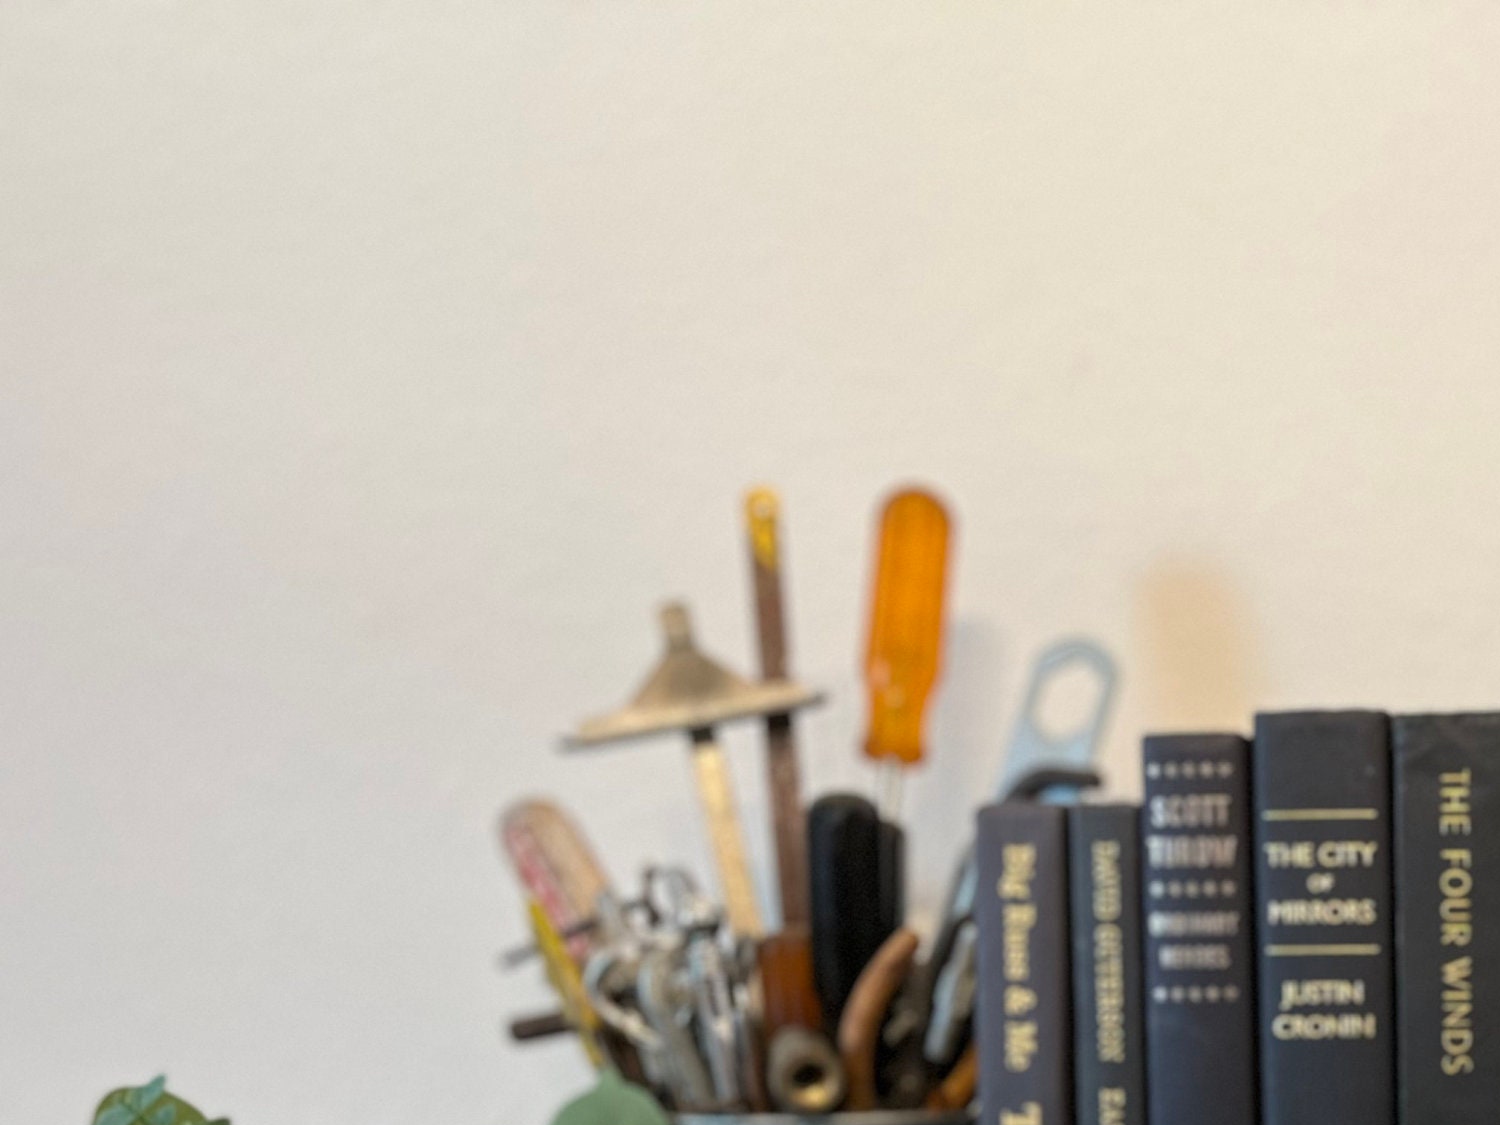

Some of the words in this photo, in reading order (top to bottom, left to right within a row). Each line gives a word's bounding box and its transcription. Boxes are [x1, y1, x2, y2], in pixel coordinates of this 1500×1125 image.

[1150, 794, 1232, 830] SCOTT
[1439, 769, 1472, 834] THE
[998, 843, 1036, 899] Big
[1263, 841, 1313, 868] THE
[1316, 840, 1377, 868] CITY
[1306, 872, 1335, 894] OF
[1439, 848, 1473, 946] FOUR
[1266, 898, 1376, 925] MIRRORS
[1002, 903, 1037, 981] Russ
[1004, 985, 1036, 1015] &
[1279, 979, 1365, 1012] JUSTIN
[1271, 1013, 1376, 1040] CRONIN
[1441, 956, 1474, 1075] WINDS
[1004, 1021, 1037, 1071] Me
